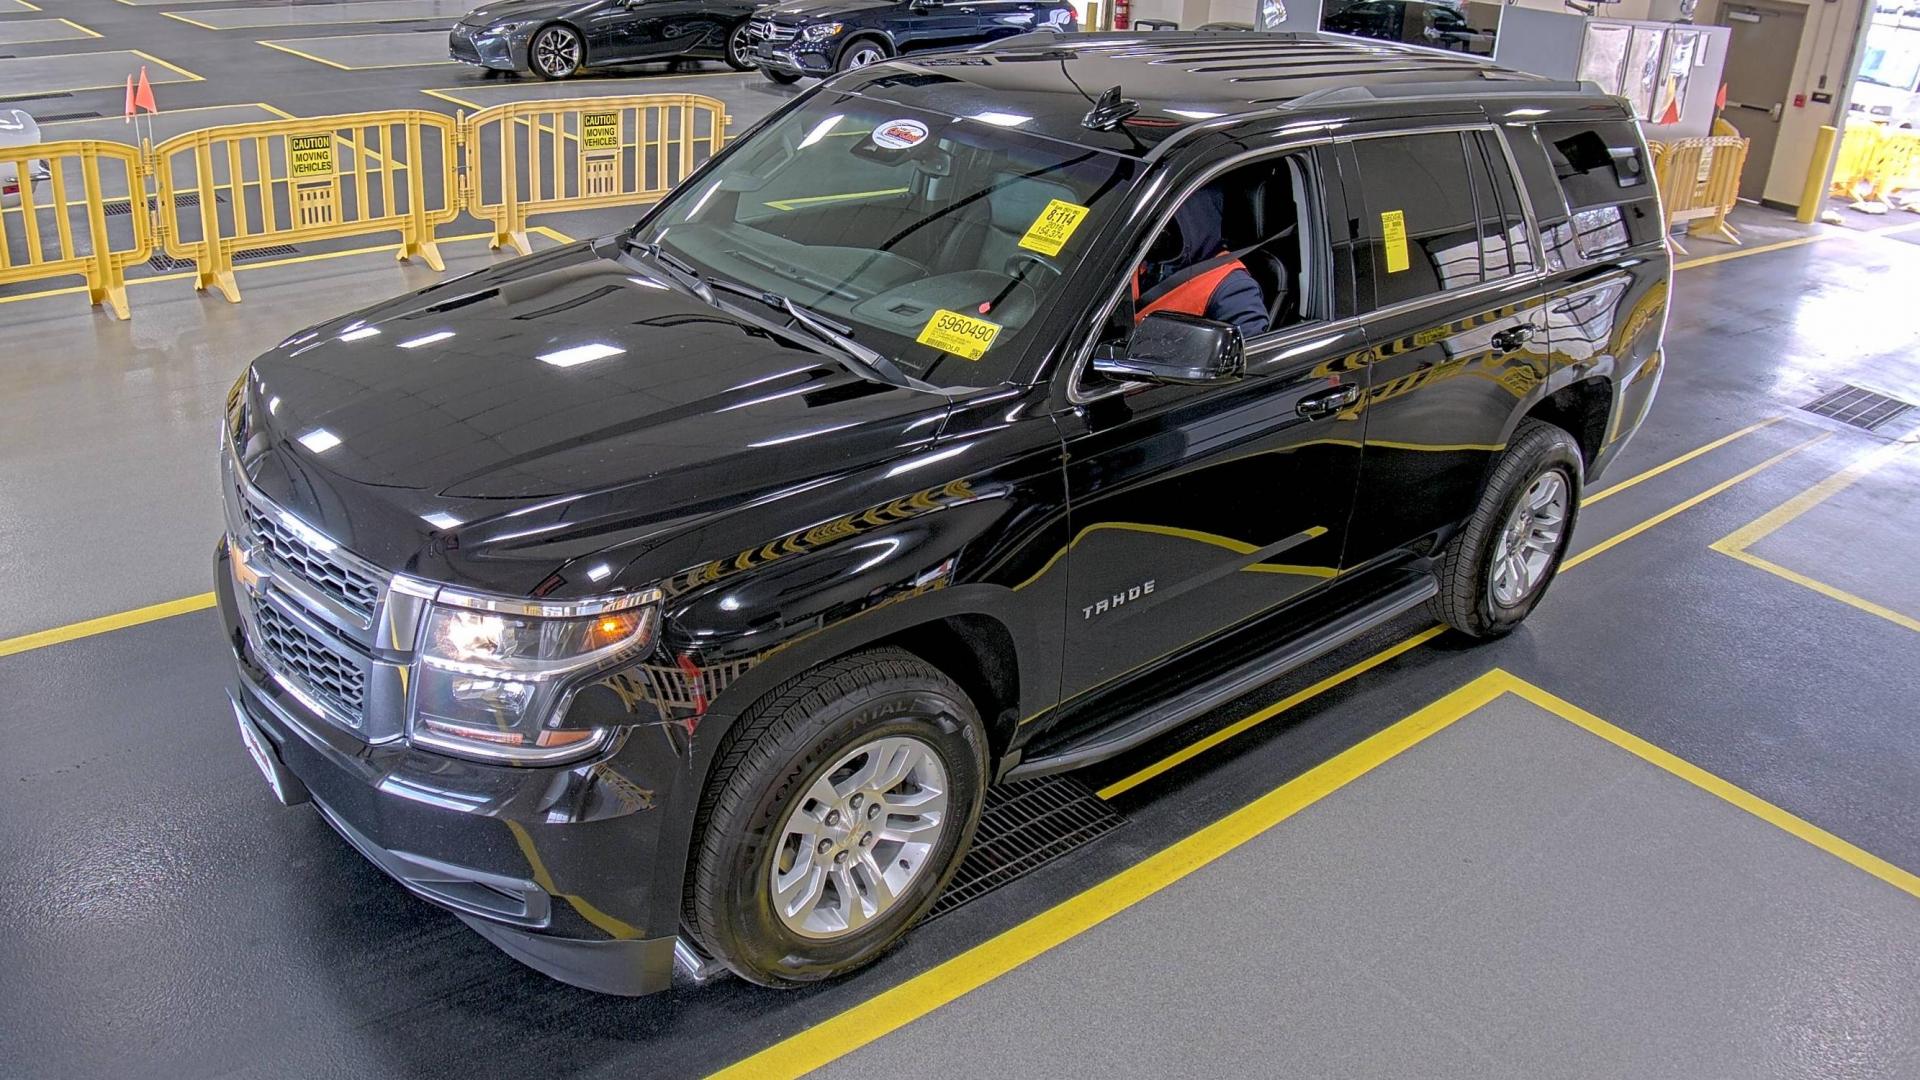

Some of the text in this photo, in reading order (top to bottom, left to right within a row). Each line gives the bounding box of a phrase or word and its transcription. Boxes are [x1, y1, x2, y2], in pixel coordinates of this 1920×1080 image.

[585, 114, 616, 127] CAUTION
[587, 127, 615, 137] MOVING
[293, 136, 329, 150] CAUTION
[584, 137, 617, 147] VEHICLES
[295, 150, 329, 162] MOVING
[293, 161, 332, 173] VEHICLES
[1047, 221, 1065, 232] 2016
[937, 314, 995, 342] 5960490
[1082, 579, 1155, 620] TAHOE
